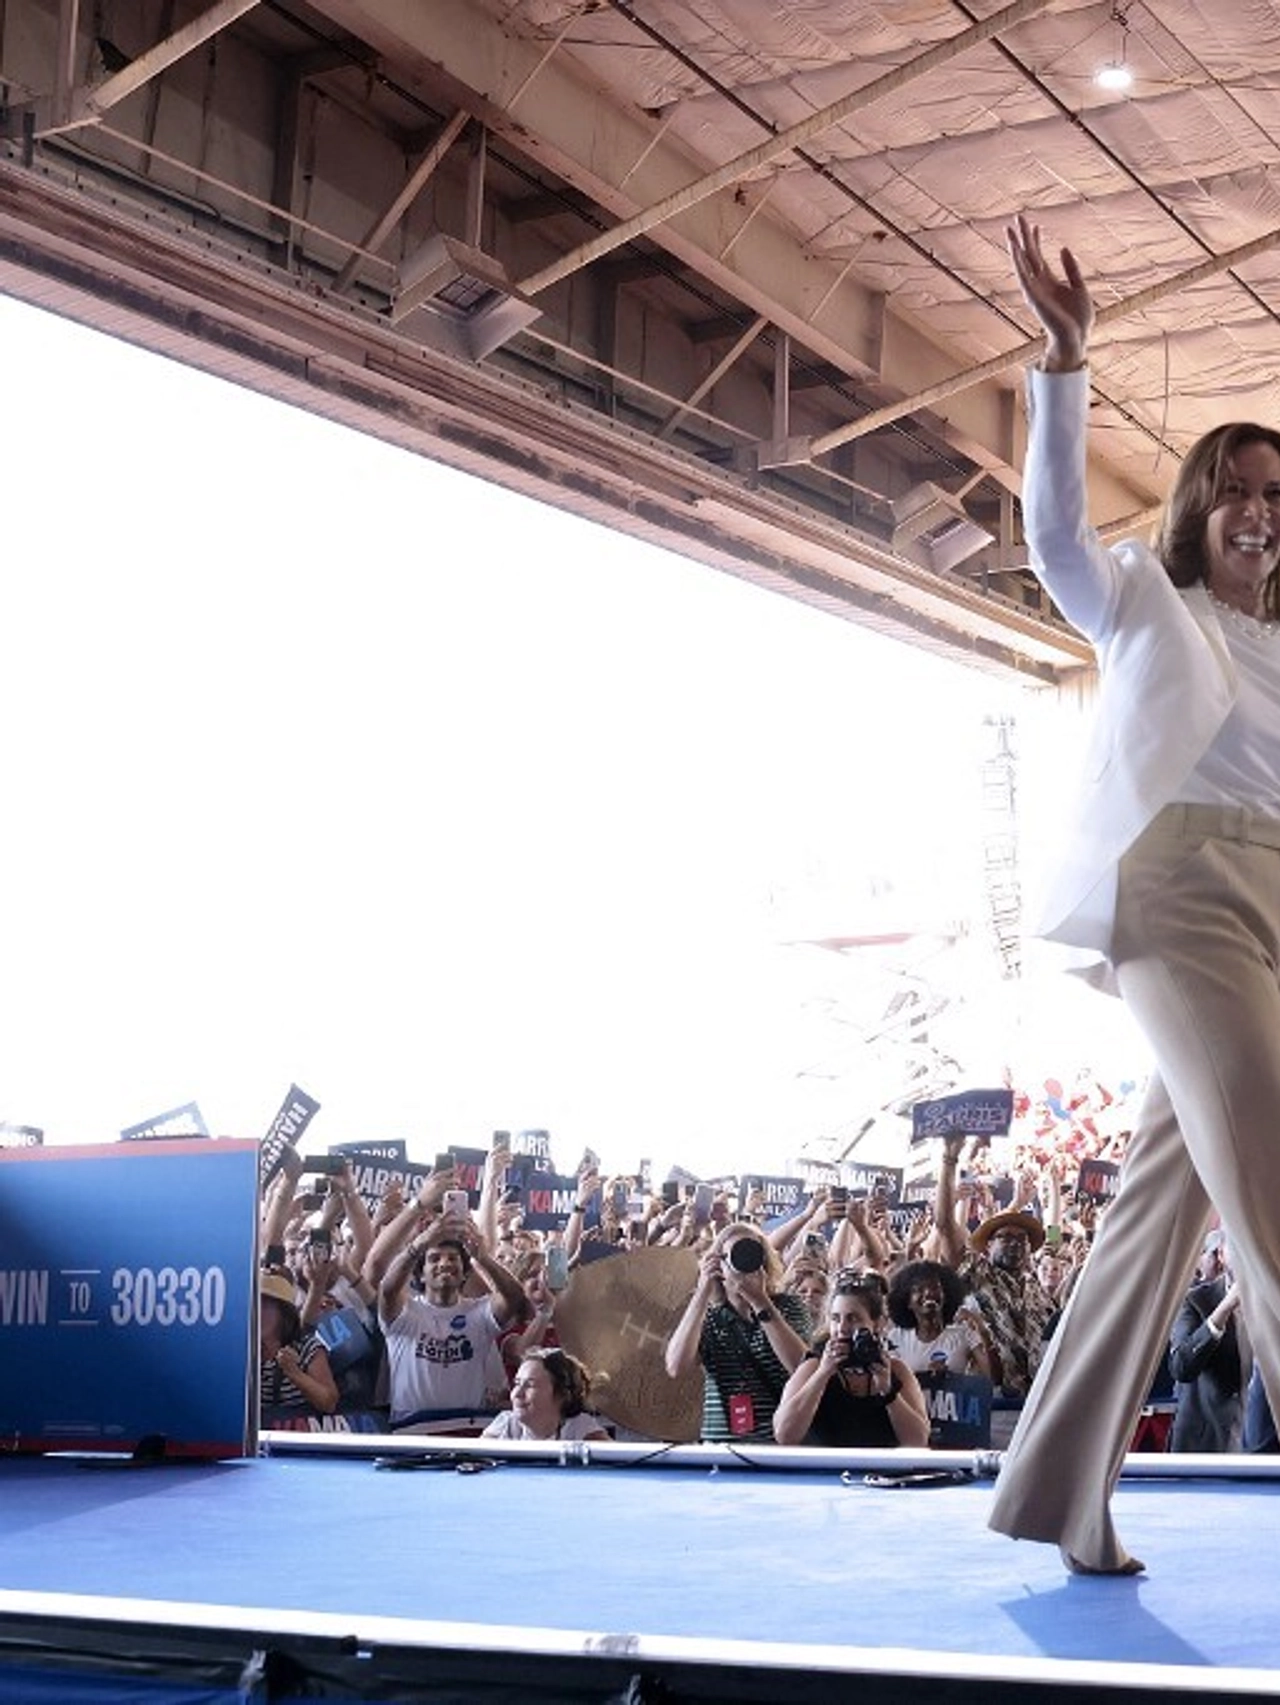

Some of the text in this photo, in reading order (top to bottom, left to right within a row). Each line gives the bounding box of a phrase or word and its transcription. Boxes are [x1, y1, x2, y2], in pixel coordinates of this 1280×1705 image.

[70, 1282, 91, 1313] TO
[110, 1266, 226, 1327] 30330
[921, 1389, 981, 1426] MALA
